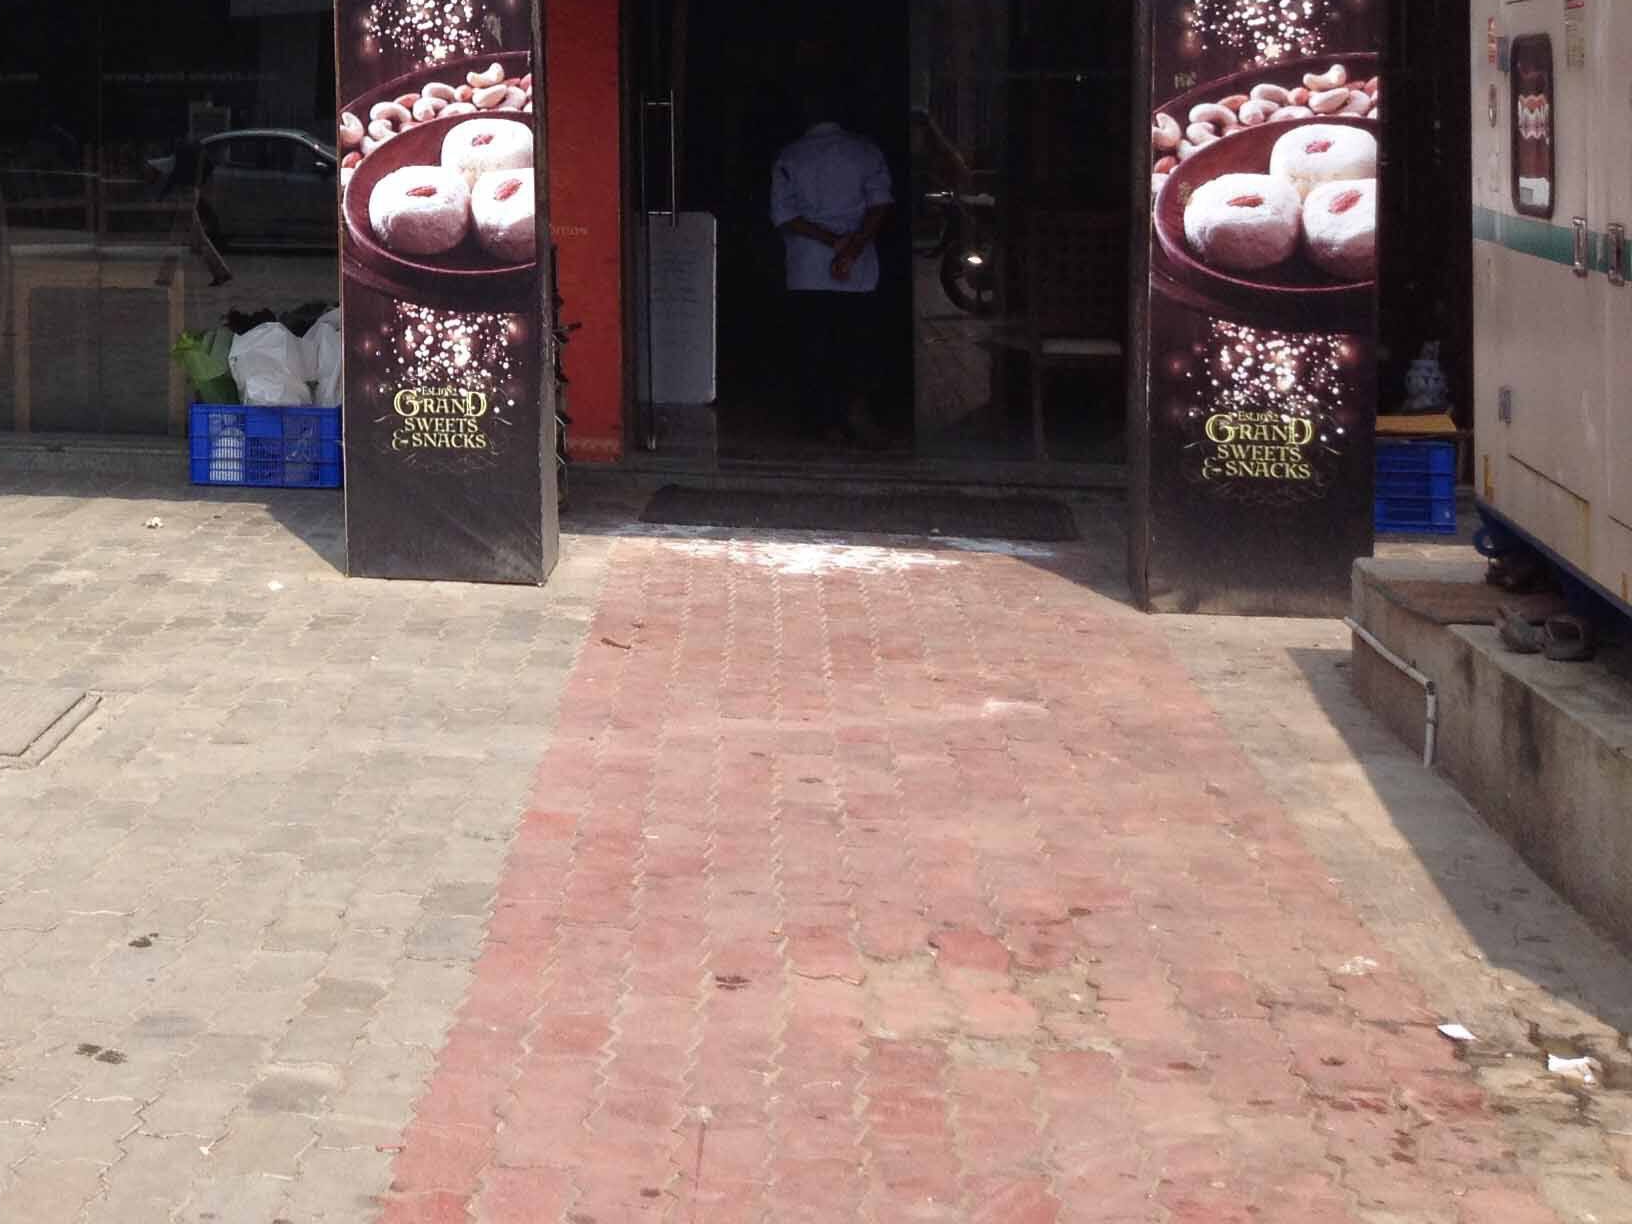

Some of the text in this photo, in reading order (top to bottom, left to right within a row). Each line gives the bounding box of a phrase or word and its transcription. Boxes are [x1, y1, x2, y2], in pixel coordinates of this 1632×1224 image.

[394, 388, 487, 417] GRAND
[404, 417, 479, 433] SWEETS
[1205, 413, 1312, 445] GRAND
[412, 432, 487, 449] SNACKS
[1216, 443, 1302, 463] SWEETS
[1224, 460, 1312, 480] SNACKS
